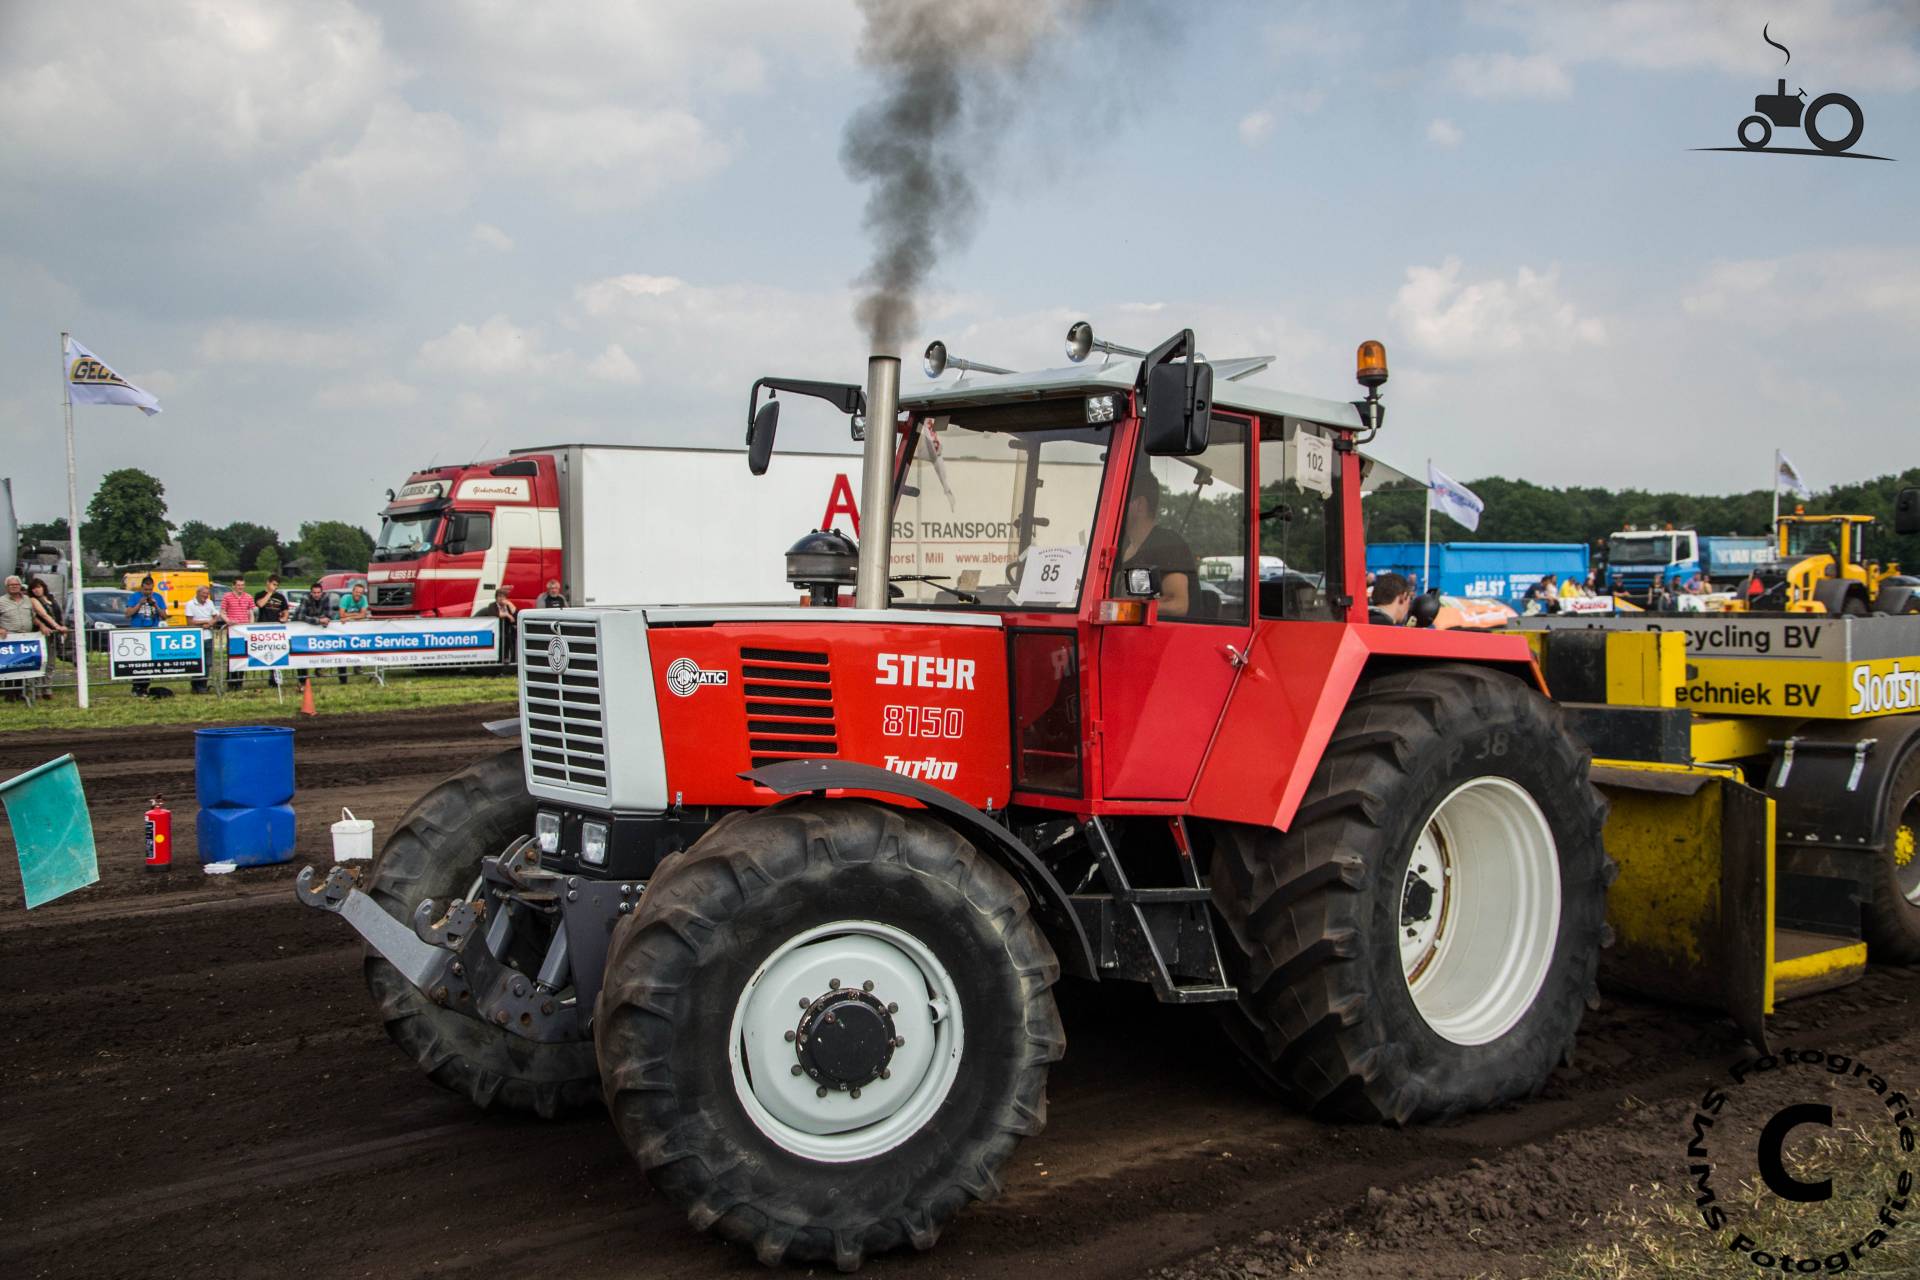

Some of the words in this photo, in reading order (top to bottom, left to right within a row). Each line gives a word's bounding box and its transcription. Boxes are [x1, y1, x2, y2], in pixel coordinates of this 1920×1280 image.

[1307, 452, 1324, 472] 102
[892, 522, 914, 539] RS
[925, 552, 944, 564] Mill
[955, 551, 1020, 564] www.albersh
[1040, 564, 1060, 582] 85
[155, 634, 197, 650] T&B
[250, 632, 286, 642] BOSCH
[308, 637, 347, 649] Bosch
[350, 636, 372, 648] Car
[374, 635, 419, 647] Service
[422, 633, 478, 646] Thoonen
[1647, 624, 1770, 653] cycling
[1784, 625, 1821, 648] BV
[0, 644, 15, 655] st
[20, 643, 38, 654] bv
[250, 642, 287, 652] Service
[690, 671, 726, 684] MATIC
[876, 653, 975, 690] STEYR
[1675, 680, 1772, 706] echniek
[1784, 683, 1821, 707] BV
[882, 704, 964, 739] 8150
[884, 755, 959, 780] Turbo
